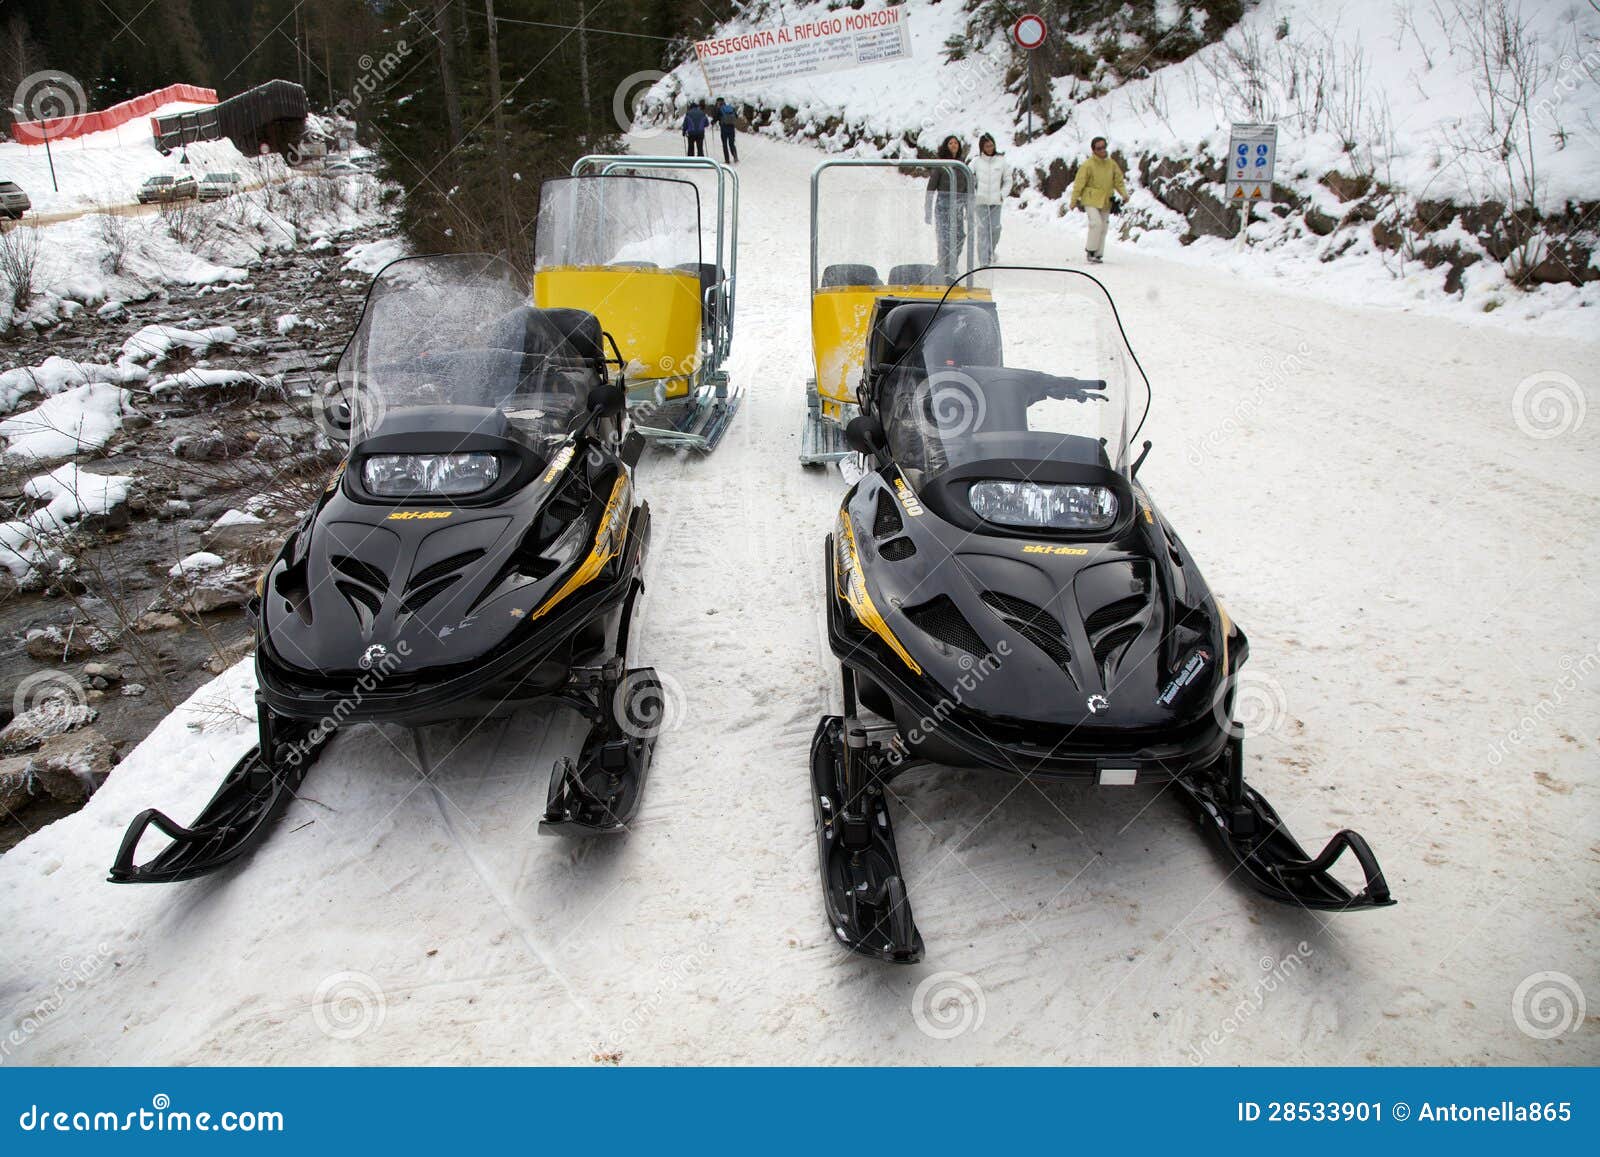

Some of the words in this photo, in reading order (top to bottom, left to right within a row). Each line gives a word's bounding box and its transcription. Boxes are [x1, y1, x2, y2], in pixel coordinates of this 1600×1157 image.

[696, 31, 775, 58] PASSEGGIATA
[778, 28, 793, 43] AL
[794, 18, 842, 40] RIFUGIO
[846, 9, 899, 31] MONZONI
[1023, 545, 1089, 556] ski-doo
